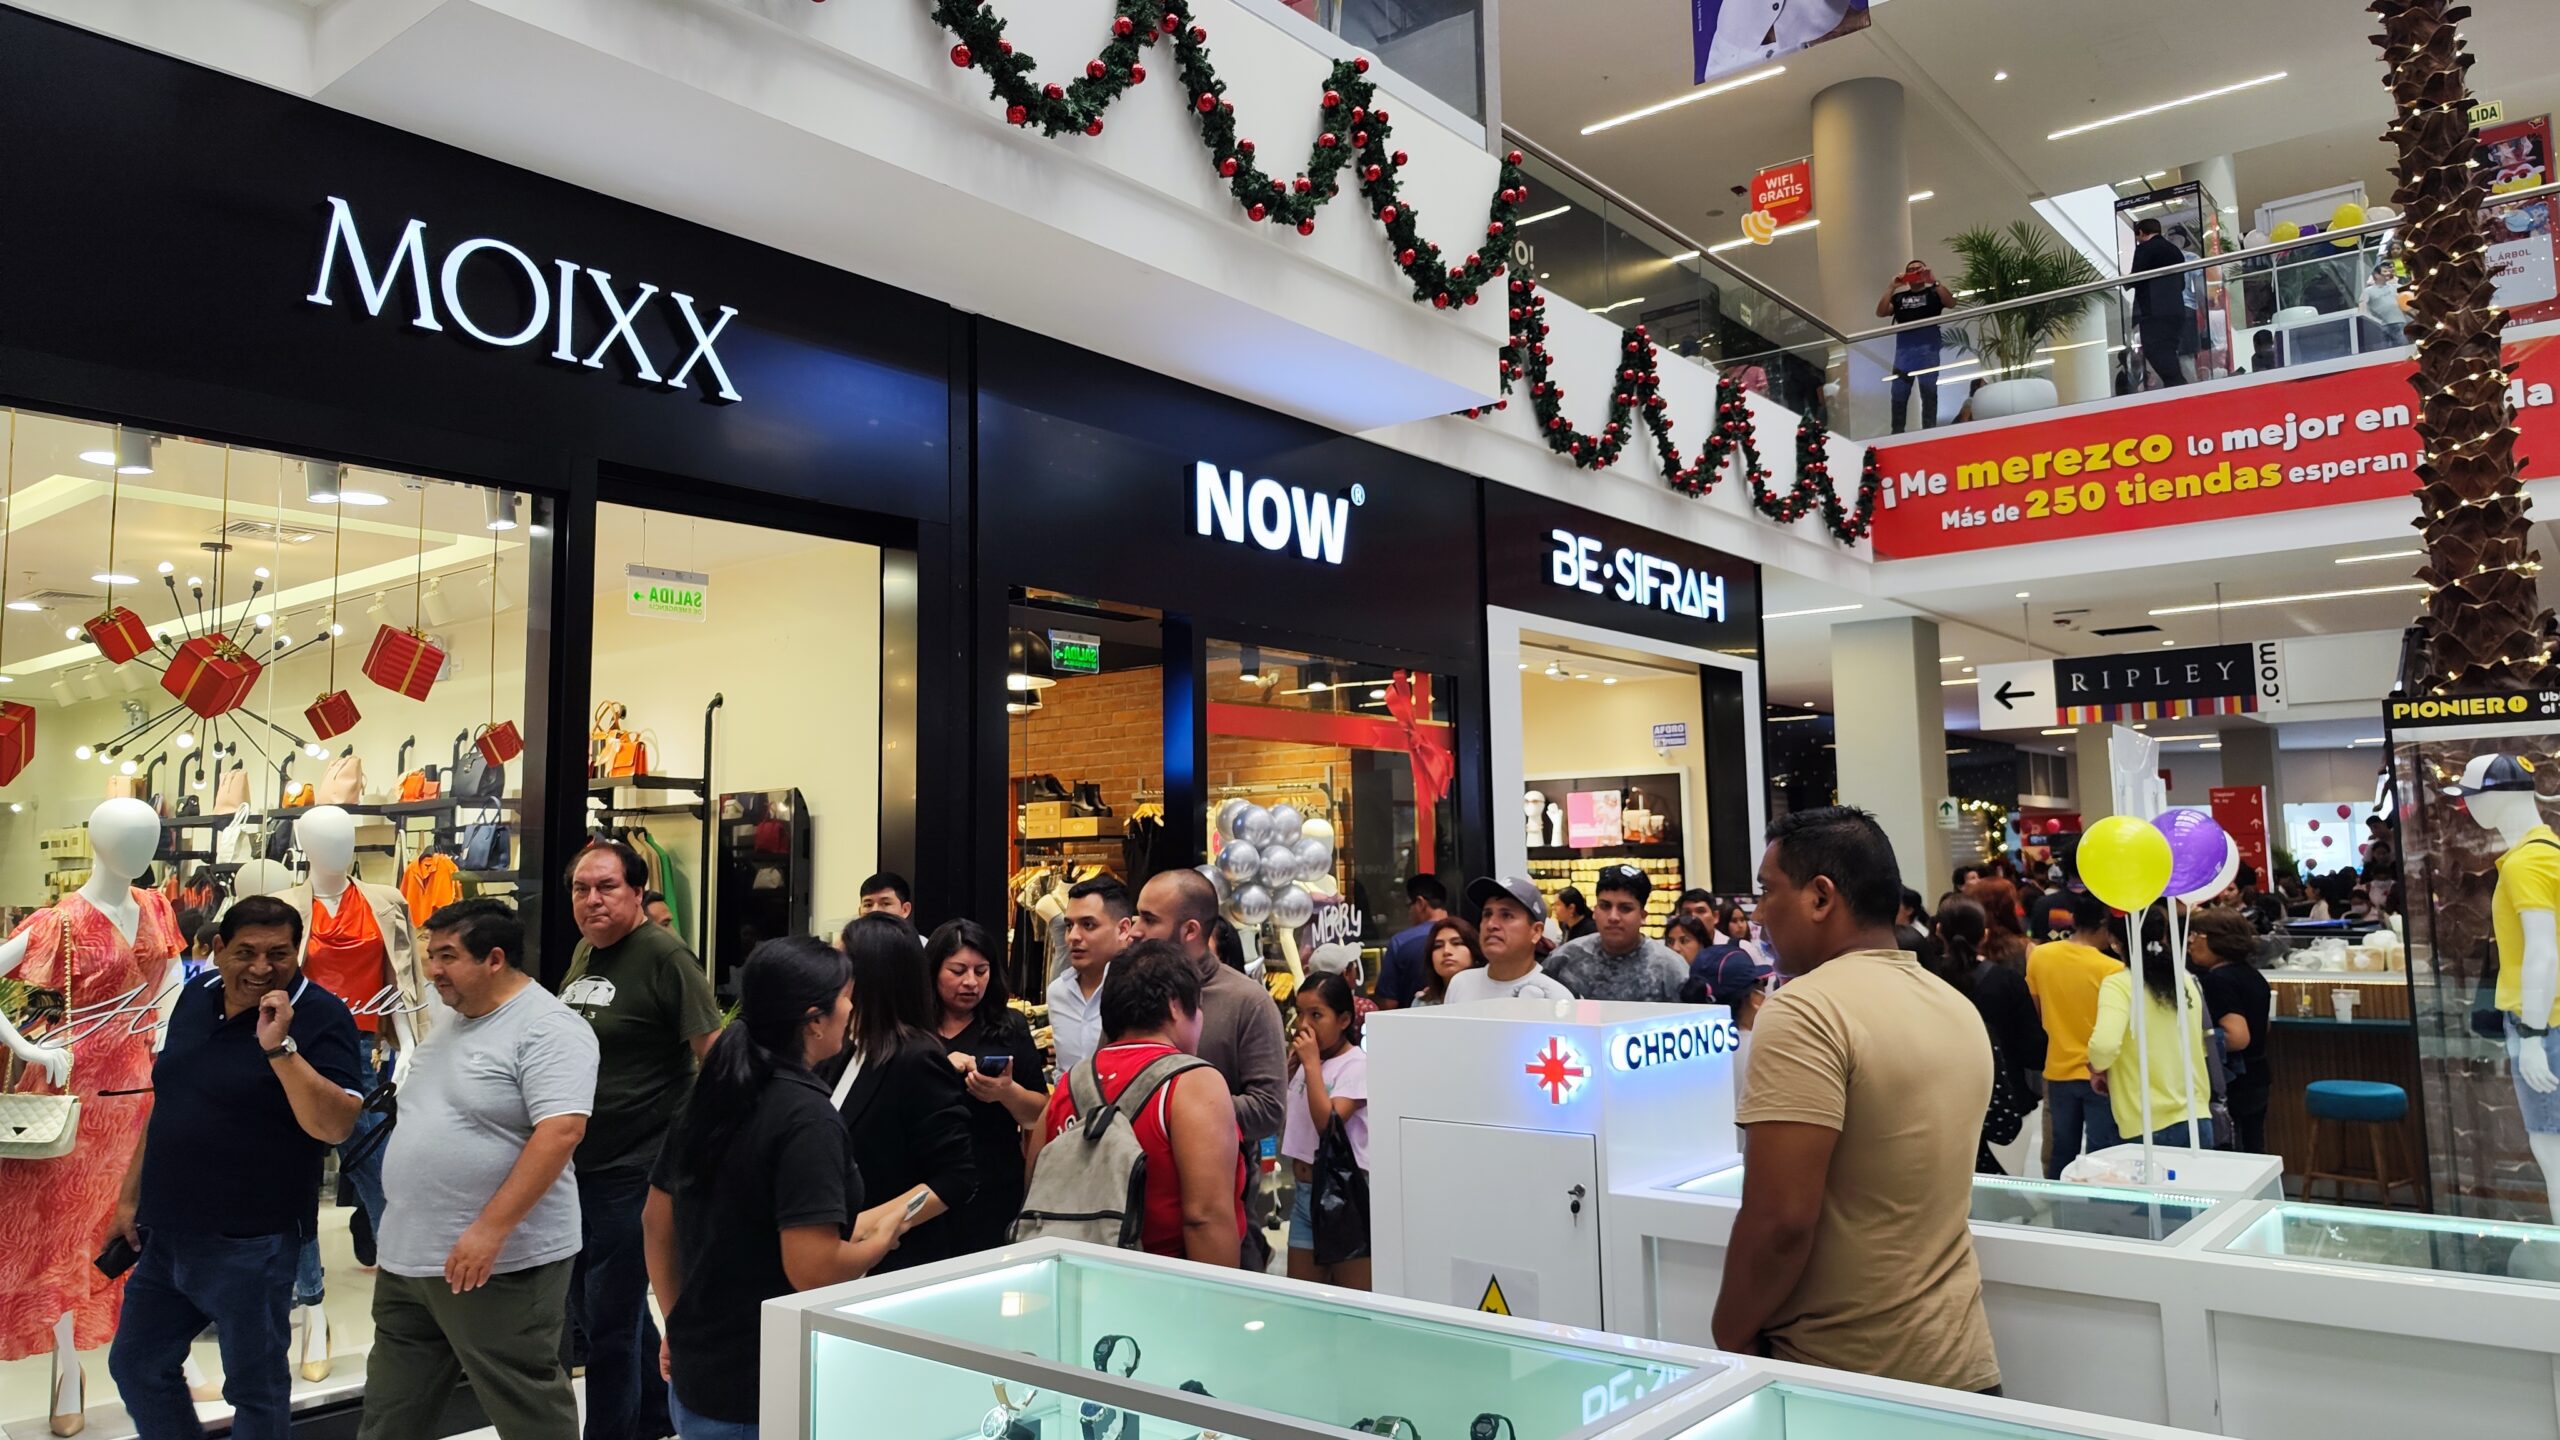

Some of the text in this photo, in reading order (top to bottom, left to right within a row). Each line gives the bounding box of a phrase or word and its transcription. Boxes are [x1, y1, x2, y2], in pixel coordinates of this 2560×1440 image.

[2468, 106, 2498, 123] LIDA
[1758, 183, 1804, 204] GRATIS
[1765, 173, 1794, 190] WIFI
[306, 195, 742, 402] MOIXX
[1956, 434, 2173, 491] merezco
[2187, 436, 2214, 456] lo
[2222, 413, 2344, 451] mejor
[2355, 404, 2410, 431] en
[1941, 504, 1986, 530] Más
[1991, 503, 2019, 524] de
[2024, 481, 2106, 519] 250
[2116, 461, 2282, 506] tiendas
[2288, 452, 2407, 484] esperan
[2070, 660, 2235, 693] RIPLEY
[2258, 642, 2279, 704] .com
[2254, 841, 2262, 853] 3
[1626, 1020, 1740, 1070] CHRONOS
